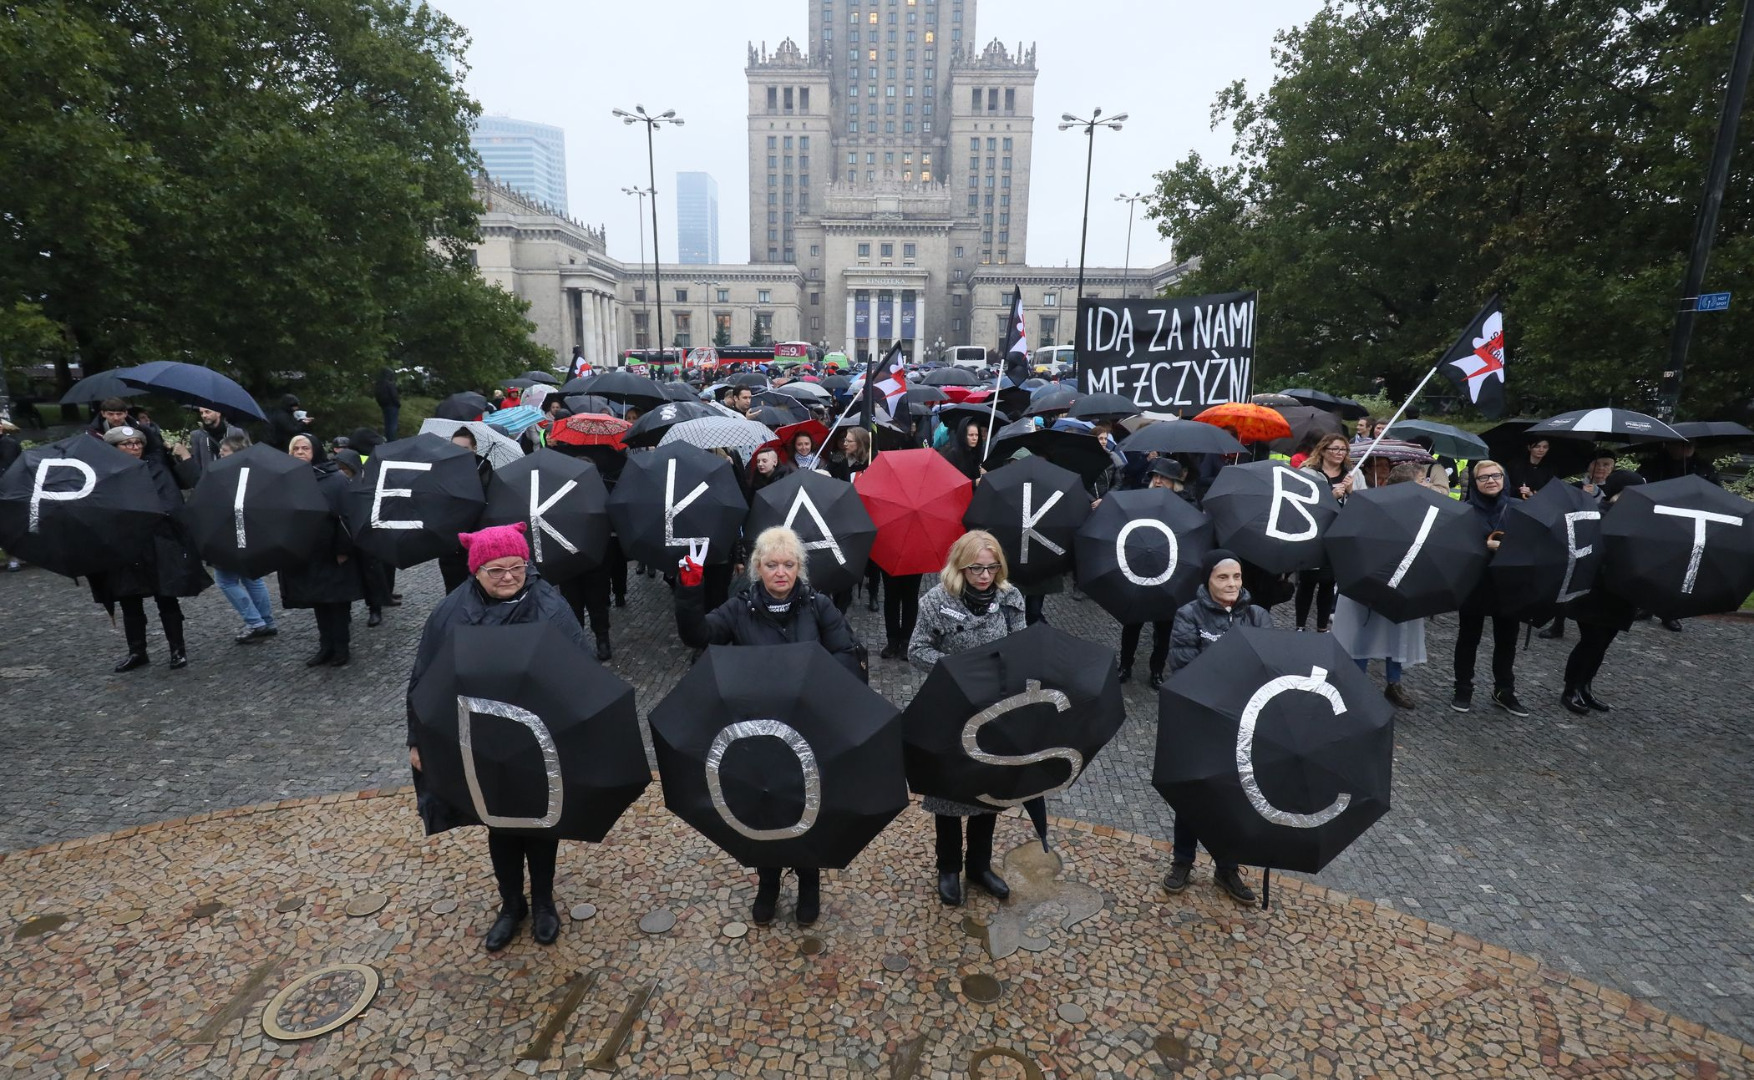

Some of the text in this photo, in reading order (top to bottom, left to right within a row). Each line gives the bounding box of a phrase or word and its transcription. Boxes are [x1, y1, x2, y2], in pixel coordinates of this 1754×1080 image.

[1086, 300, 1255, 358] IDĄ ZA NAMI
